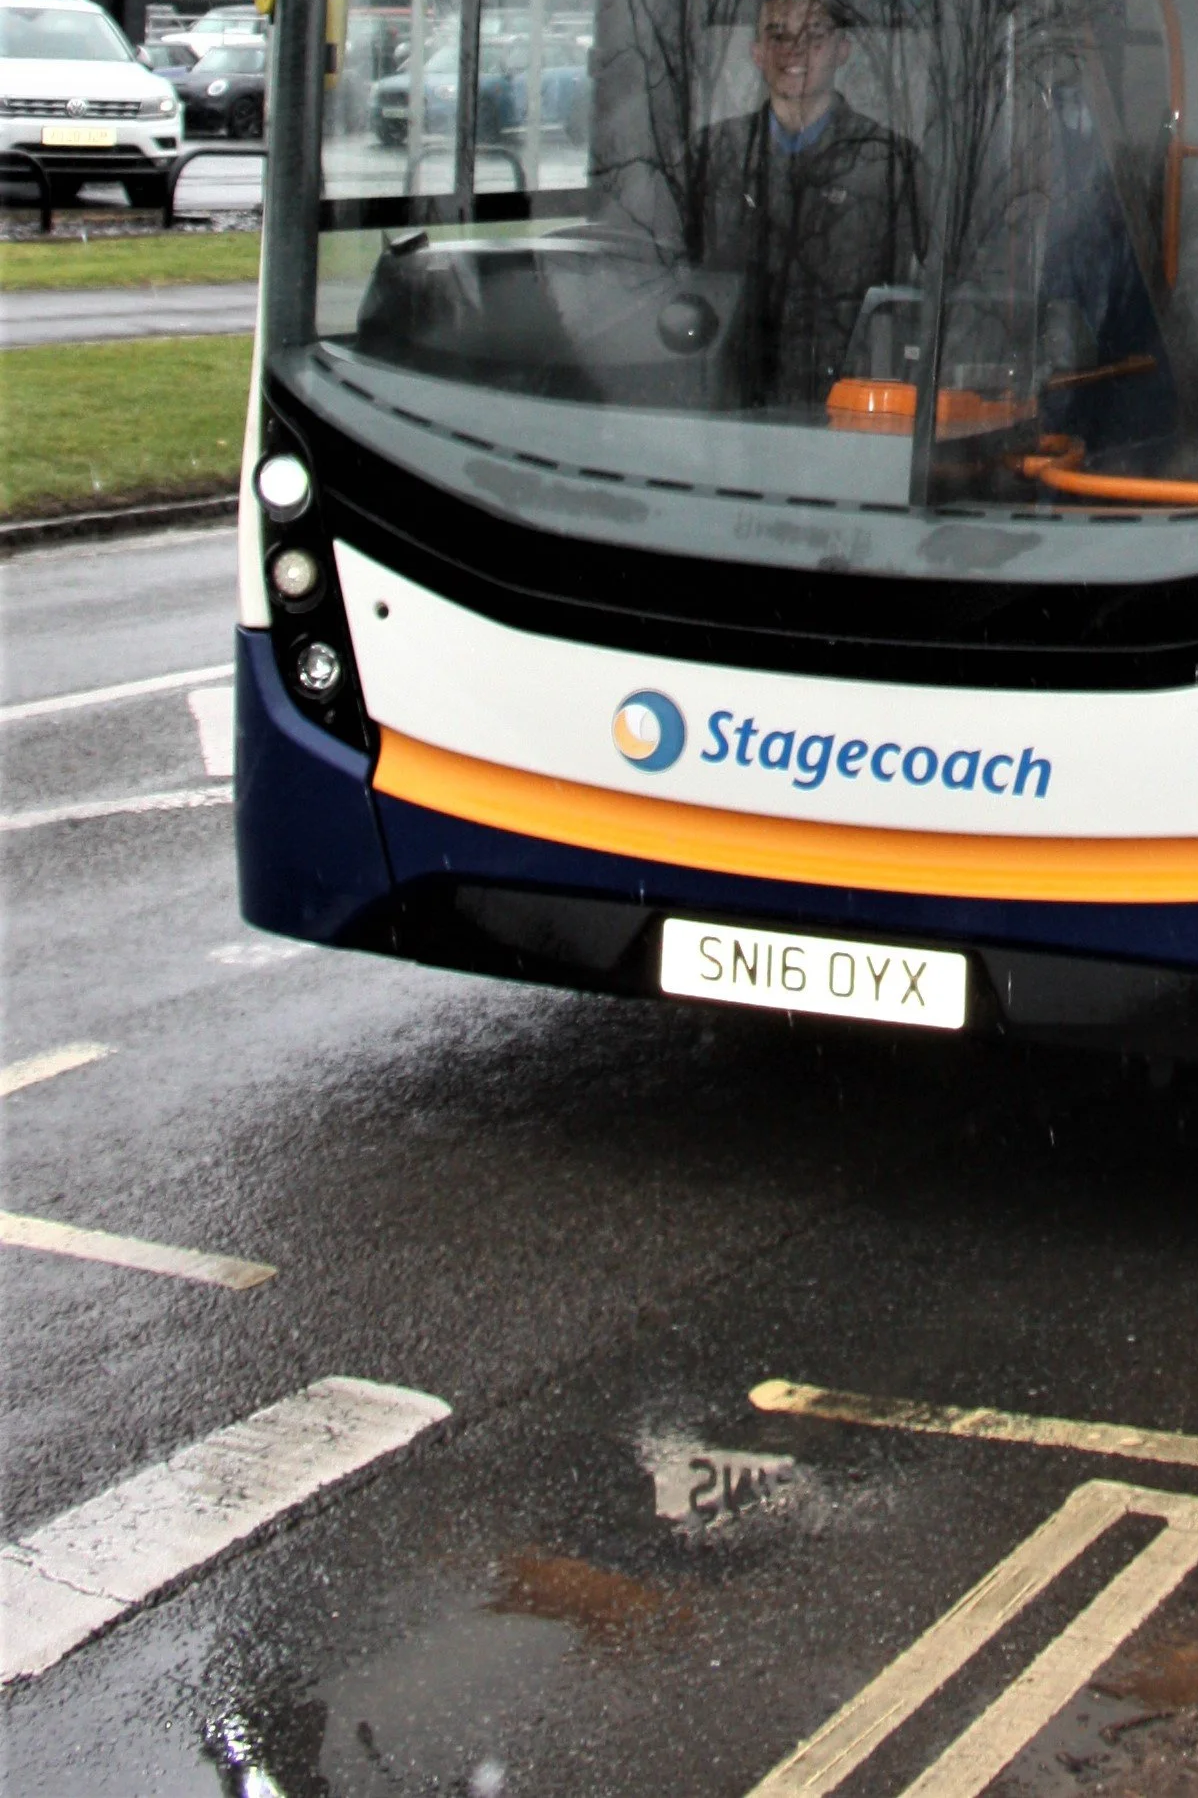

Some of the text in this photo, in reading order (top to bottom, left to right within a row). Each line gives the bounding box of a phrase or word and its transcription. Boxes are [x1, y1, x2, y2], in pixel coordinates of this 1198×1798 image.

[701, 709, 1053, 800] Stagecoach
[698, 934, 929, 1008] SN16 OYX
